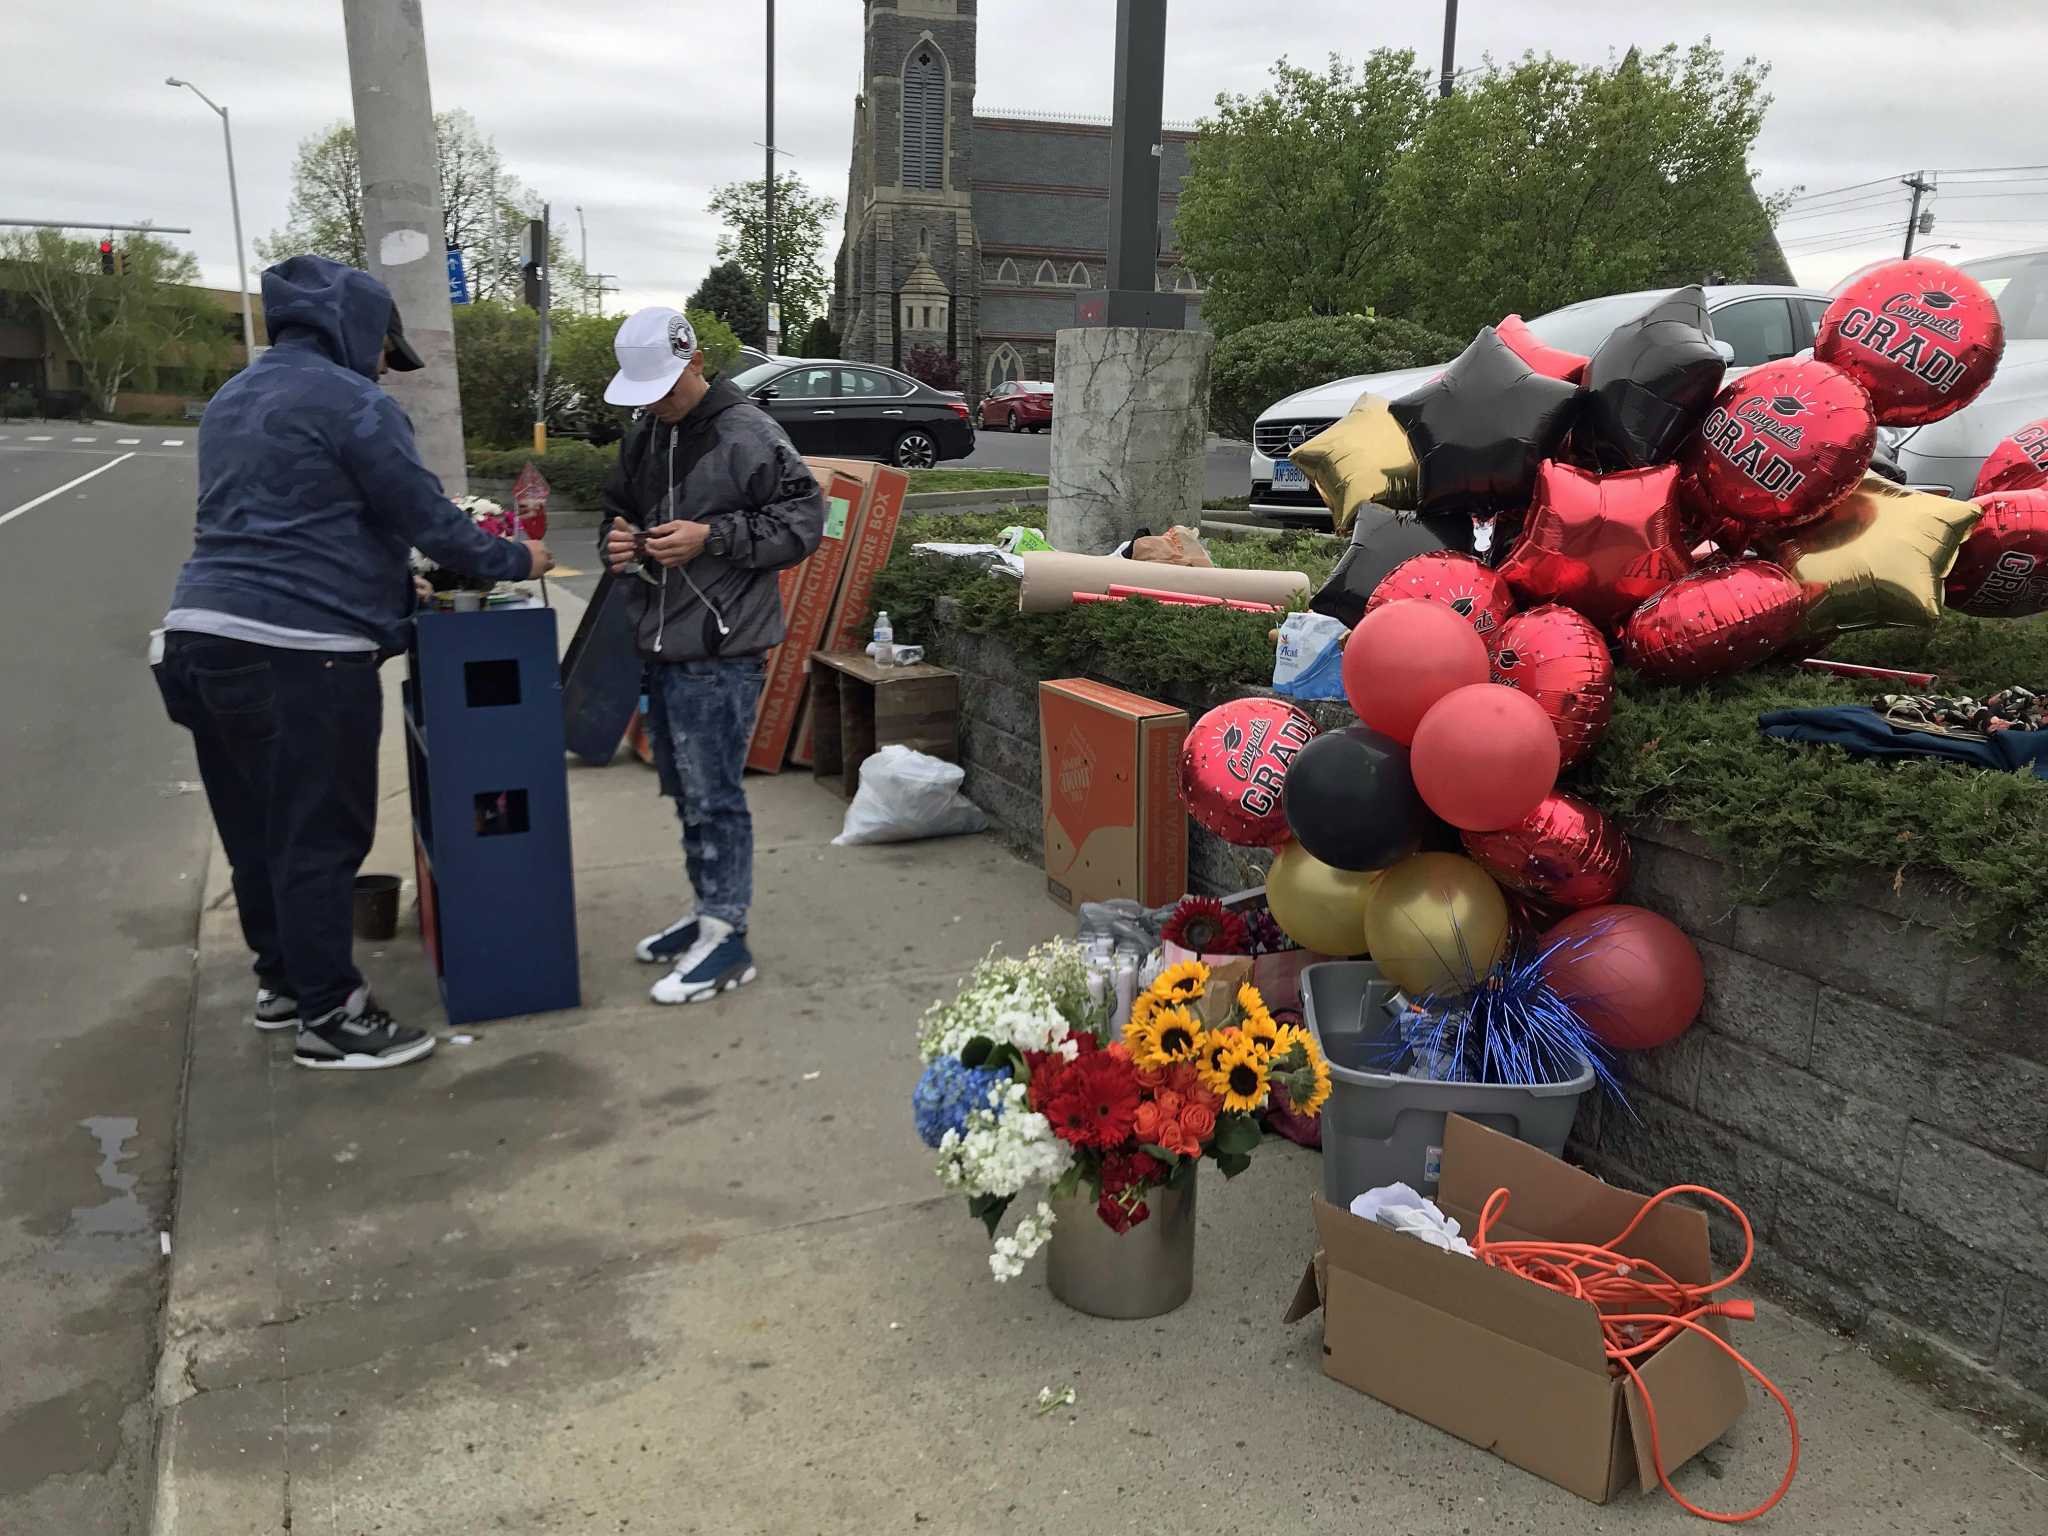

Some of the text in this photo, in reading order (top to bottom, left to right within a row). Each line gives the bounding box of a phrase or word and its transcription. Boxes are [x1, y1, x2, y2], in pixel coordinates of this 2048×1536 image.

[1839, 307, 1968, 394] GRAD!
[1881, 292, 1961, 342] Congrats
[1702, 406, 1807, 500] GRAD!
[1735, 395, 1807, 450] Congrats
[869, 491, 891, 529] BOX
[755, 698, 785, 750] EXTRA
[774, 635, 801, 694] LARGE
[1227, 717, 1272, 781] Congrats
[1240, 714, 1317, 817] GRAD!
